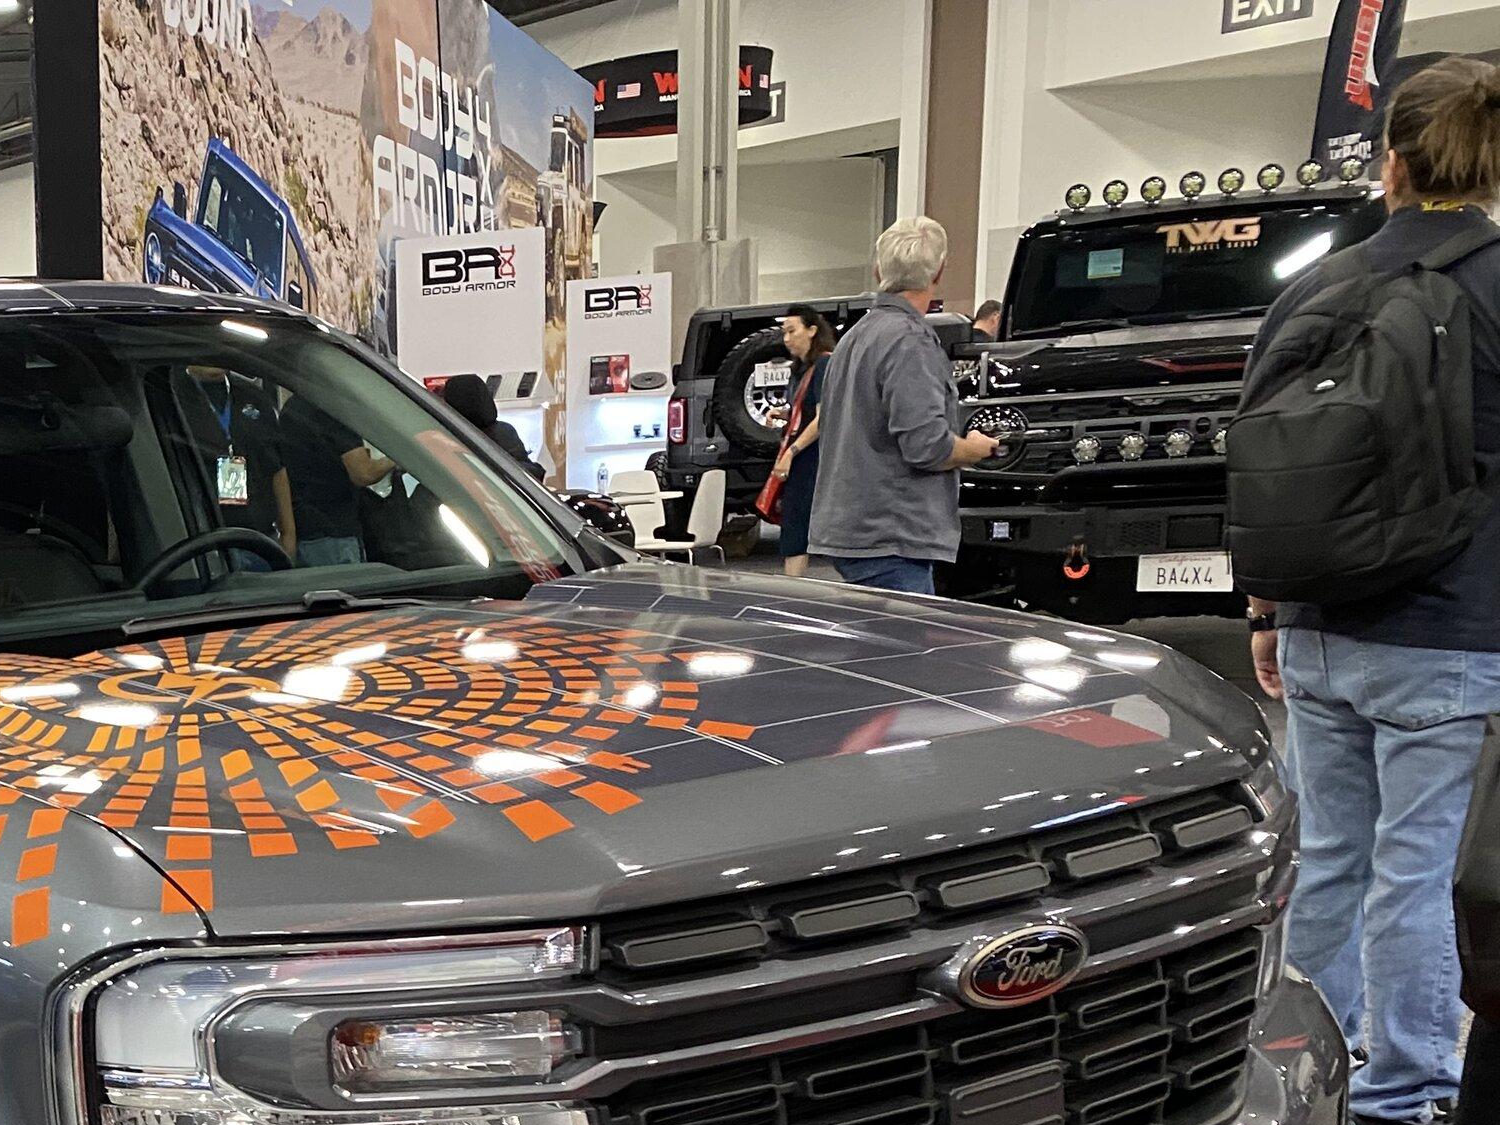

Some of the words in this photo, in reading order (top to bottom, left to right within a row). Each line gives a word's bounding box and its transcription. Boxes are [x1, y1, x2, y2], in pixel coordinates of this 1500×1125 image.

[395, 38, 474, 159] BODY
[373, 134, 478, 236] ARMOR
[422, 285, 461, 296] BODY
[465, 280, 516, 293] ARMOR
[615, 309, 652, 317] ARMOR
[1156, 567, 1213, 585] BA4X4
[997, 943, 1063, 991] Ford
